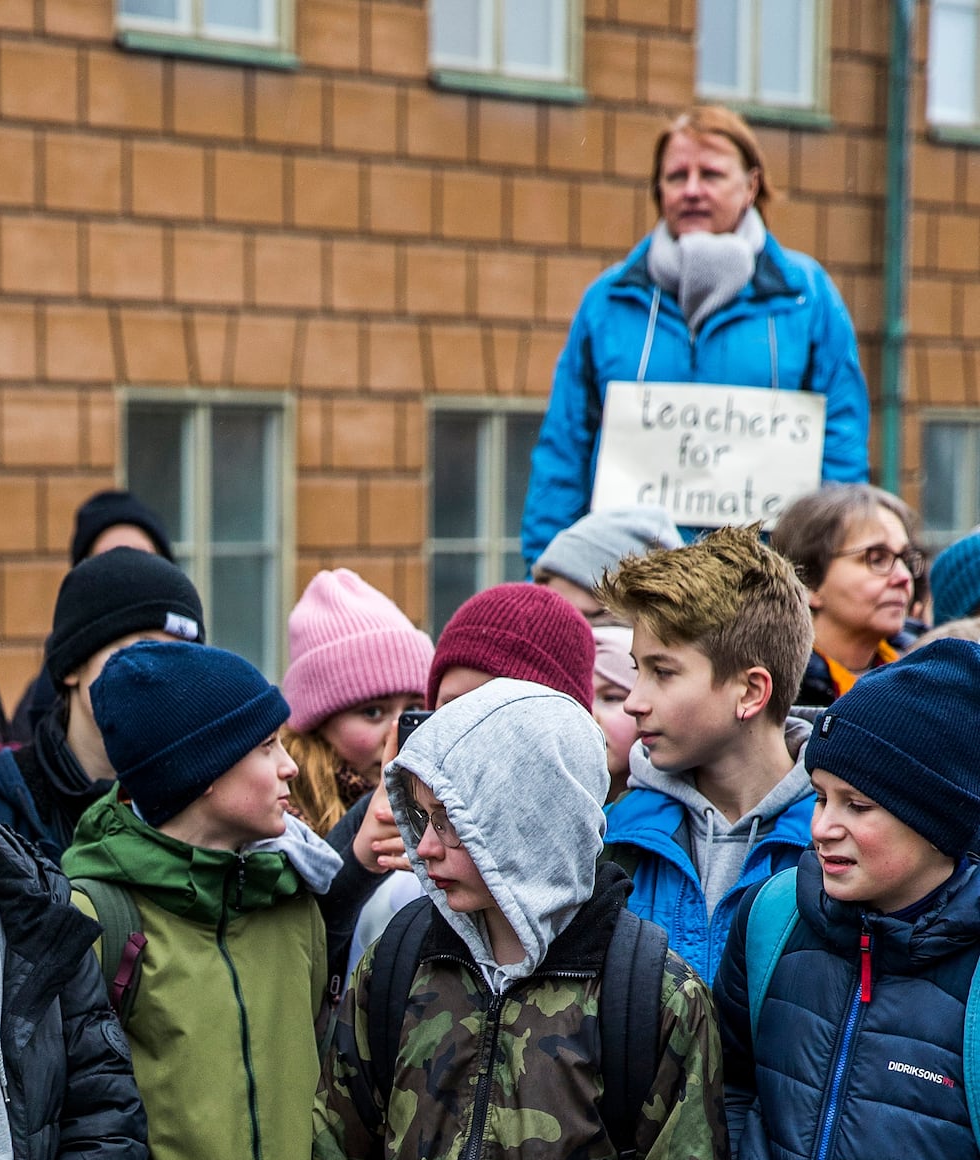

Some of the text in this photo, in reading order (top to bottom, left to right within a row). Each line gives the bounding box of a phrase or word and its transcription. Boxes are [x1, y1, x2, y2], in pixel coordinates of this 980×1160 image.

[641, 387, 813, 443] teachers
[677, 432, 732, 468] for
[637, 472, 783, 518] climate
[888, 1061, 944, 1084] DIDRIKSONS
